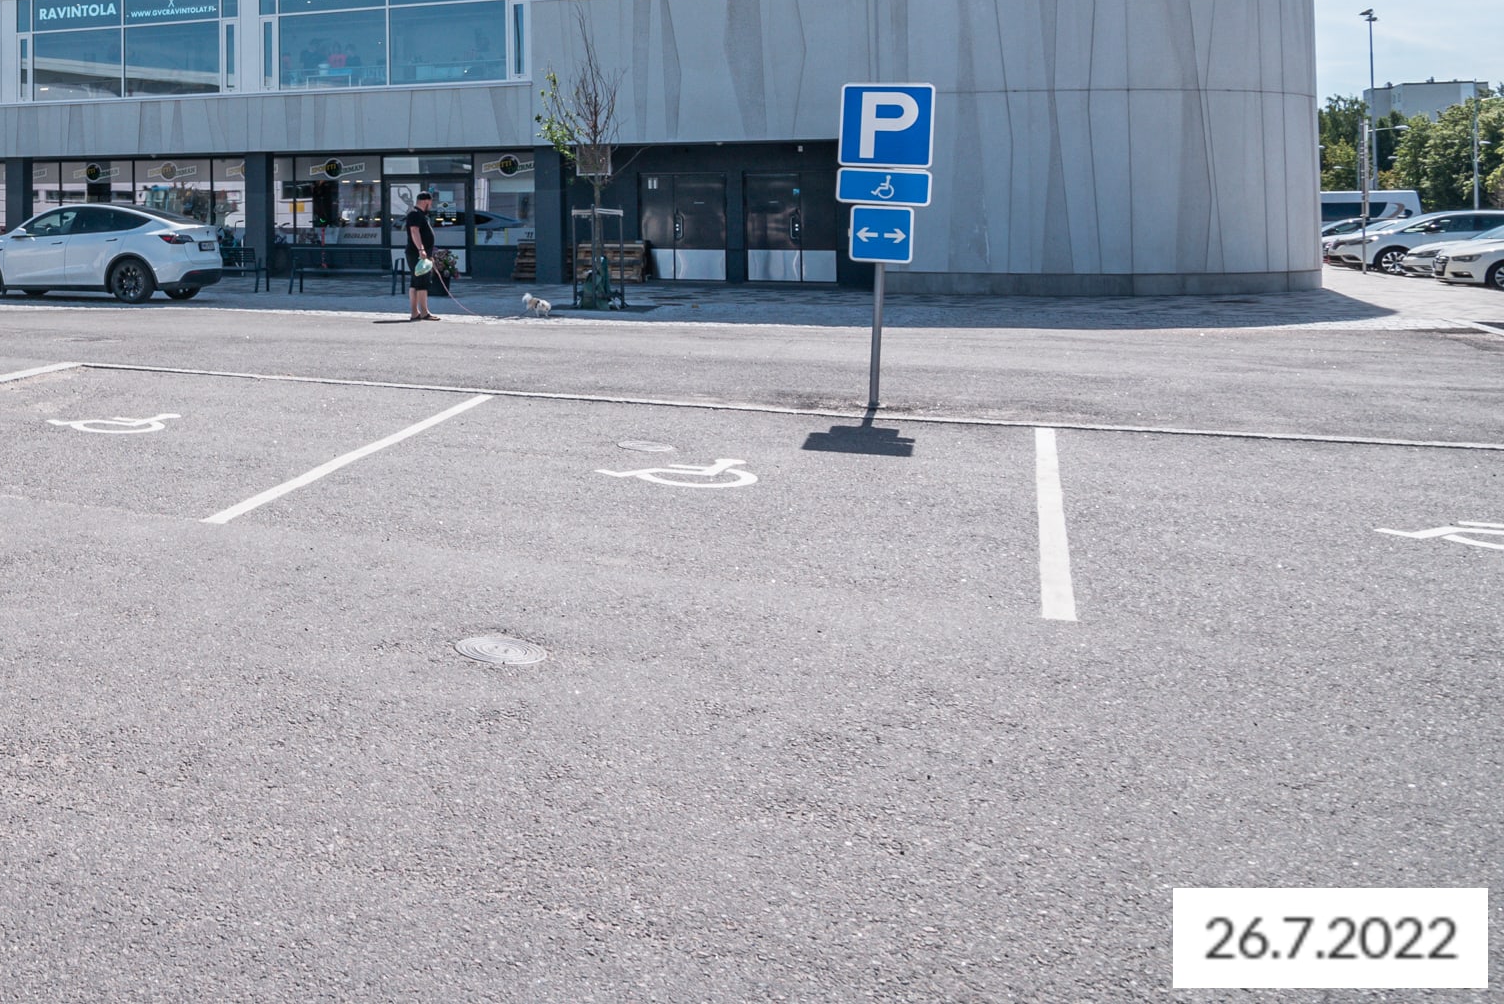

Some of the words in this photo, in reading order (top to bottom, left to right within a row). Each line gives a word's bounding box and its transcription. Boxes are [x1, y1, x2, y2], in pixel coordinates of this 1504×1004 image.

[39, 2, 117, 21] RAVINTOLA
[130, 5, 215, 18] WWW.GVCRAVINTOLAT.FI
[859, 91, 919, 159] P
